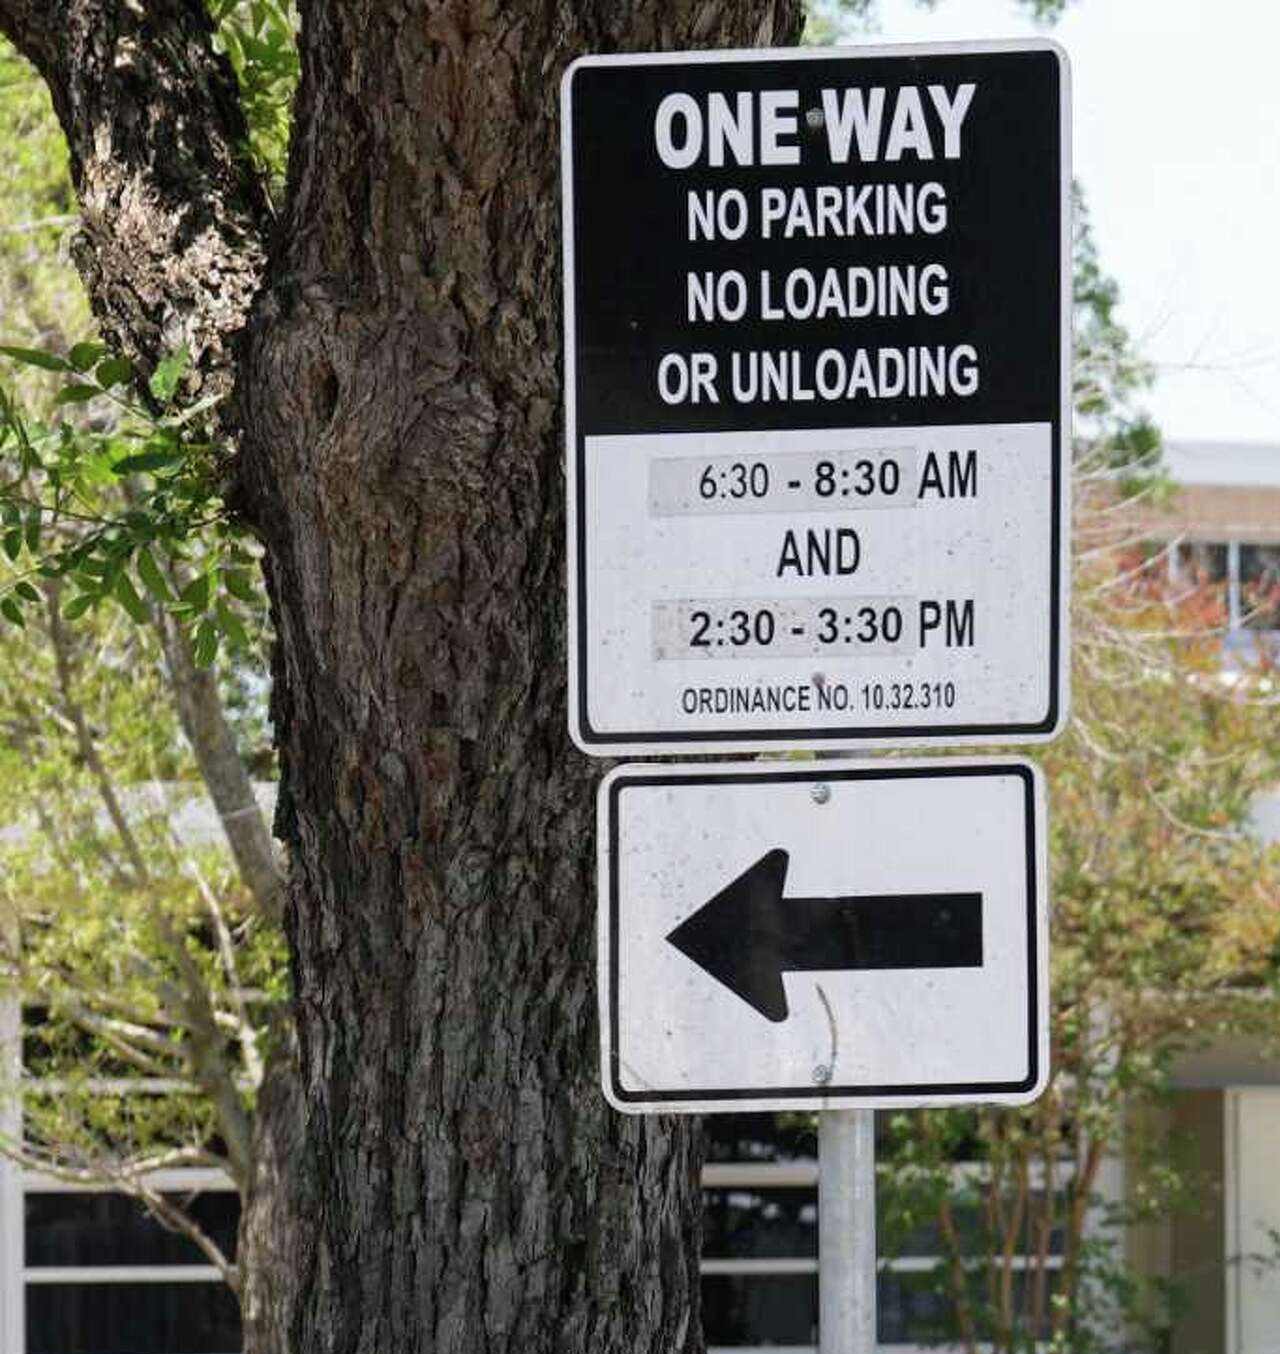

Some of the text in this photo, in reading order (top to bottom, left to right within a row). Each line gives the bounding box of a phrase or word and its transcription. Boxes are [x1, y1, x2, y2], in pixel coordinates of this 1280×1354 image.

[655, 83, 977, 170] ONE WAY
[687, 181, 948, 242] NO PARKING
[687, 263, 950, 323] NO LOADING
[657, 344, 980, 405] OR UNLOADING
[699, 450, 978, 500] 6:30 - 8:30 AM
[776, 528, 861, 578] AND
[689, 599, 975, 648] 2:30 - 3:30 PM
[682, 681, 956, 714] ORDINANCE NO. 10.32.310
